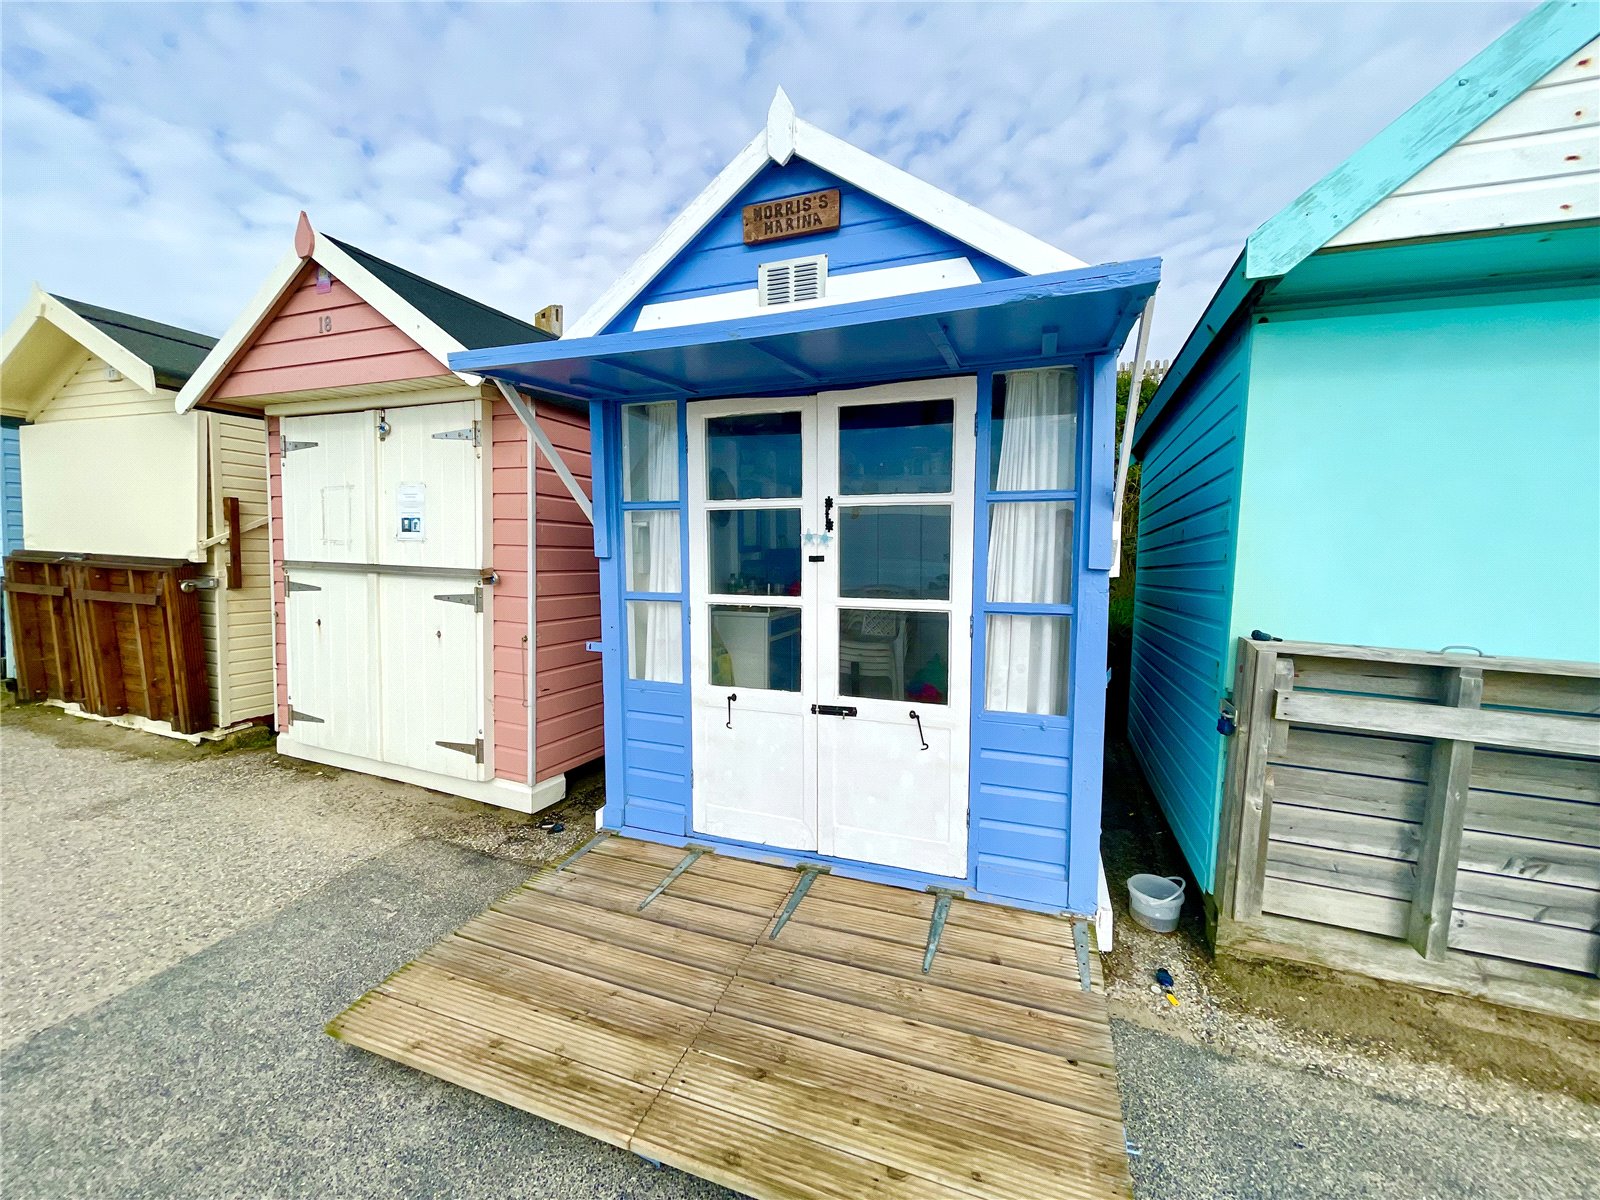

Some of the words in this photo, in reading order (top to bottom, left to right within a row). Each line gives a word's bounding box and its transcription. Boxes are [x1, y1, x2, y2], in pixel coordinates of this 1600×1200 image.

[753, 194, 829, 221] MORRIS'S
[764, 212, 822, 235] MARINA
[318, 315, 332, 334] 18
